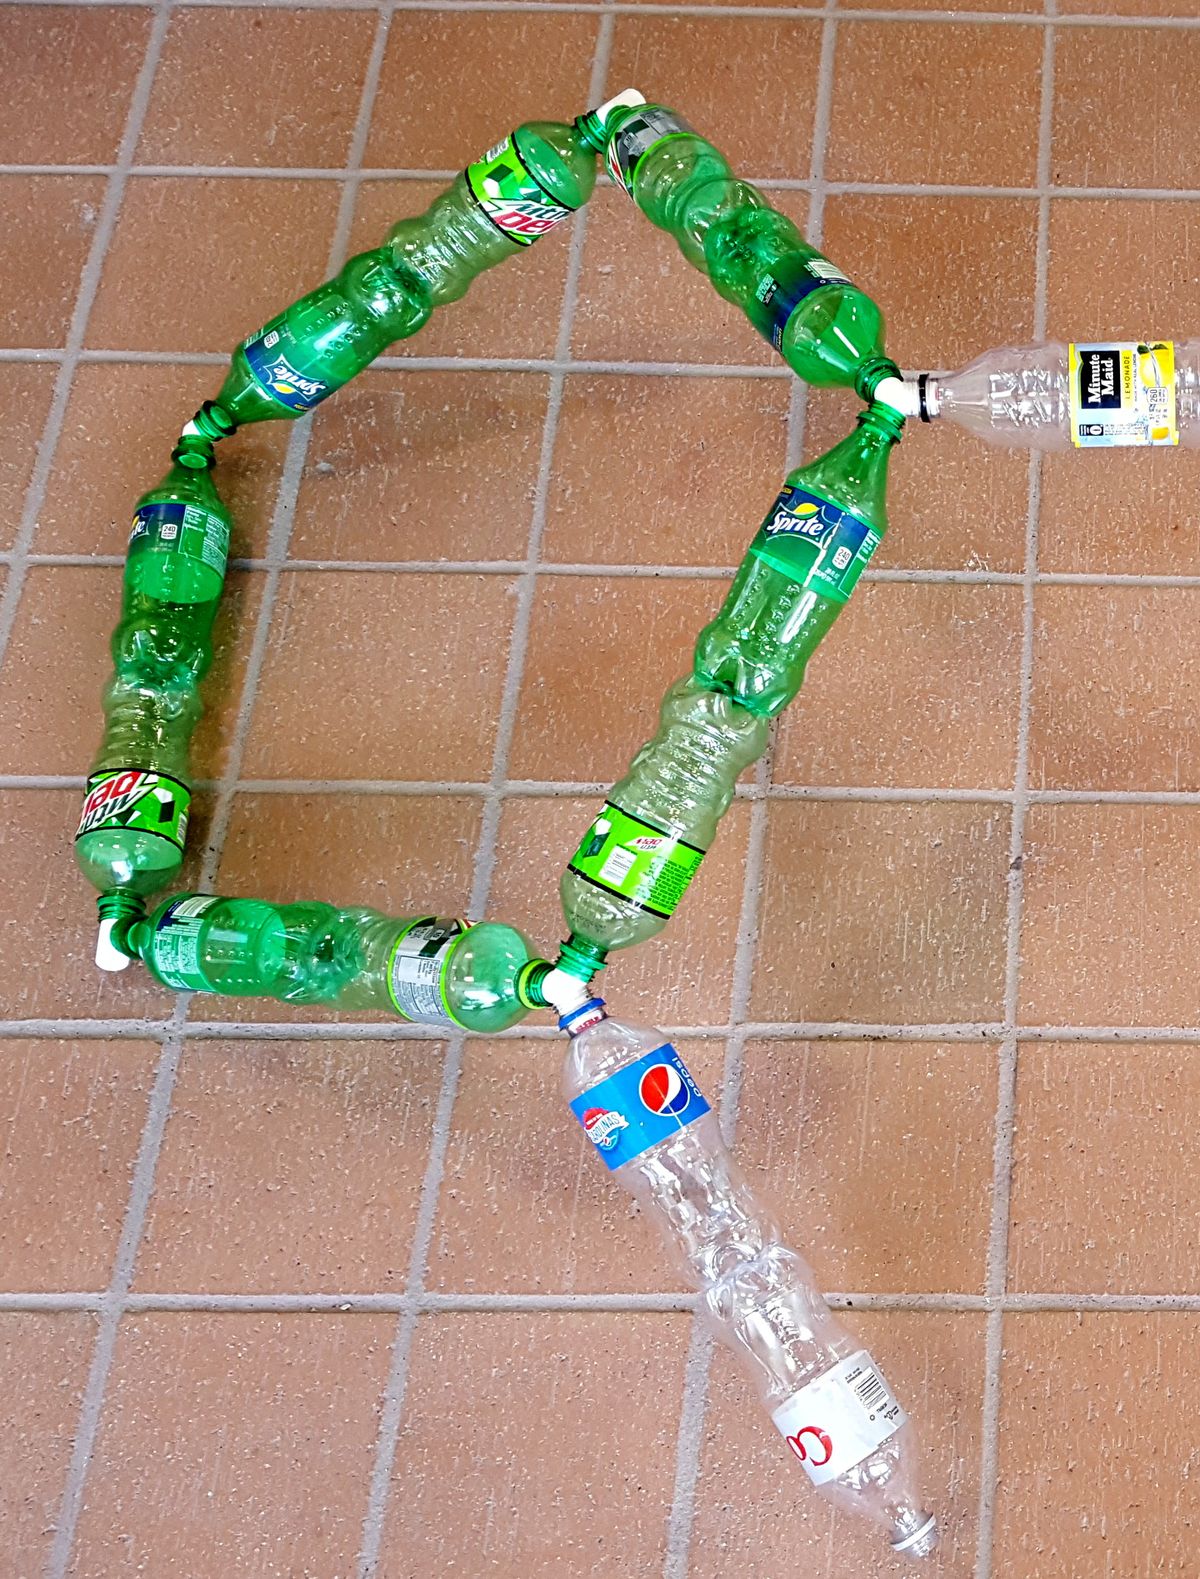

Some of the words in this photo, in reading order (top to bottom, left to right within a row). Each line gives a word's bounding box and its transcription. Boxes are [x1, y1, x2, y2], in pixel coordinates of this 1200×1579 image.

[273, 365, 327, 396] Sprite
[1087, 353, 1102, 404] Minute
[1101, 358, 1115, 396] Maid
[1123, 355, 1131, 400] LEMONADE
[1149, 388, 1158, 403] 260
[163, 525, 176, 533] 240
[766, 511, 824, 536] Sprite
[671, 1056, 702, 1098] pepsi
